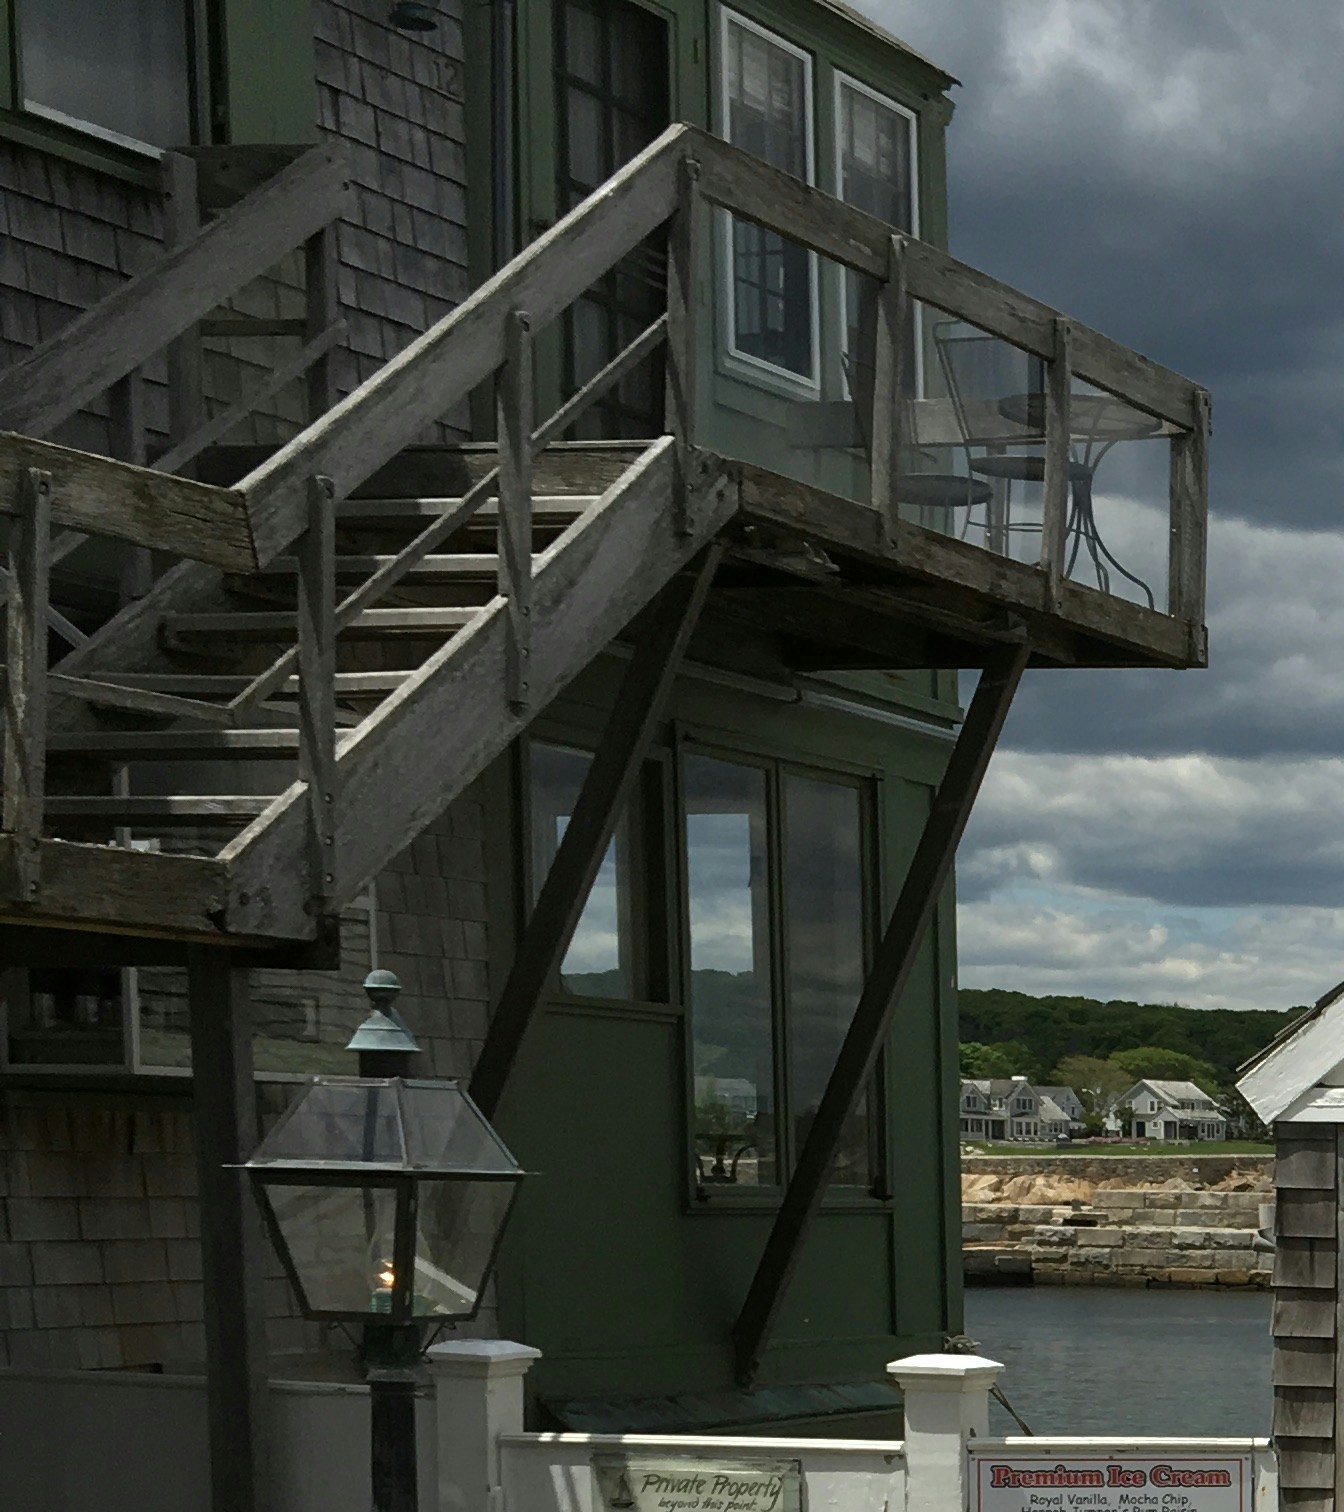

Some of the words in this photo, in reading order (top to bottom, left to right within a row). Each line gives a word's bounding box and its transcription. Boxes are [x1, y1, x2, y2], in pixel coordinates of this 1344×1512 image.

[991, 1465, 1105, 1488] Premium
[1107, 1465, 1146, 1487] Ice
[1150, 1465, 1231, 1487] Cream
[641, 1473, 706, 1495] Private
[711, 1474, 782, 1512] Property
[1030, 1495, 1063, 1507] Royal
[1068, 1494, 1111, 1506] Vanilla,
[1120, 1494, 1158, 1504] Mocha
[701, 1498, 724, 1510] this
